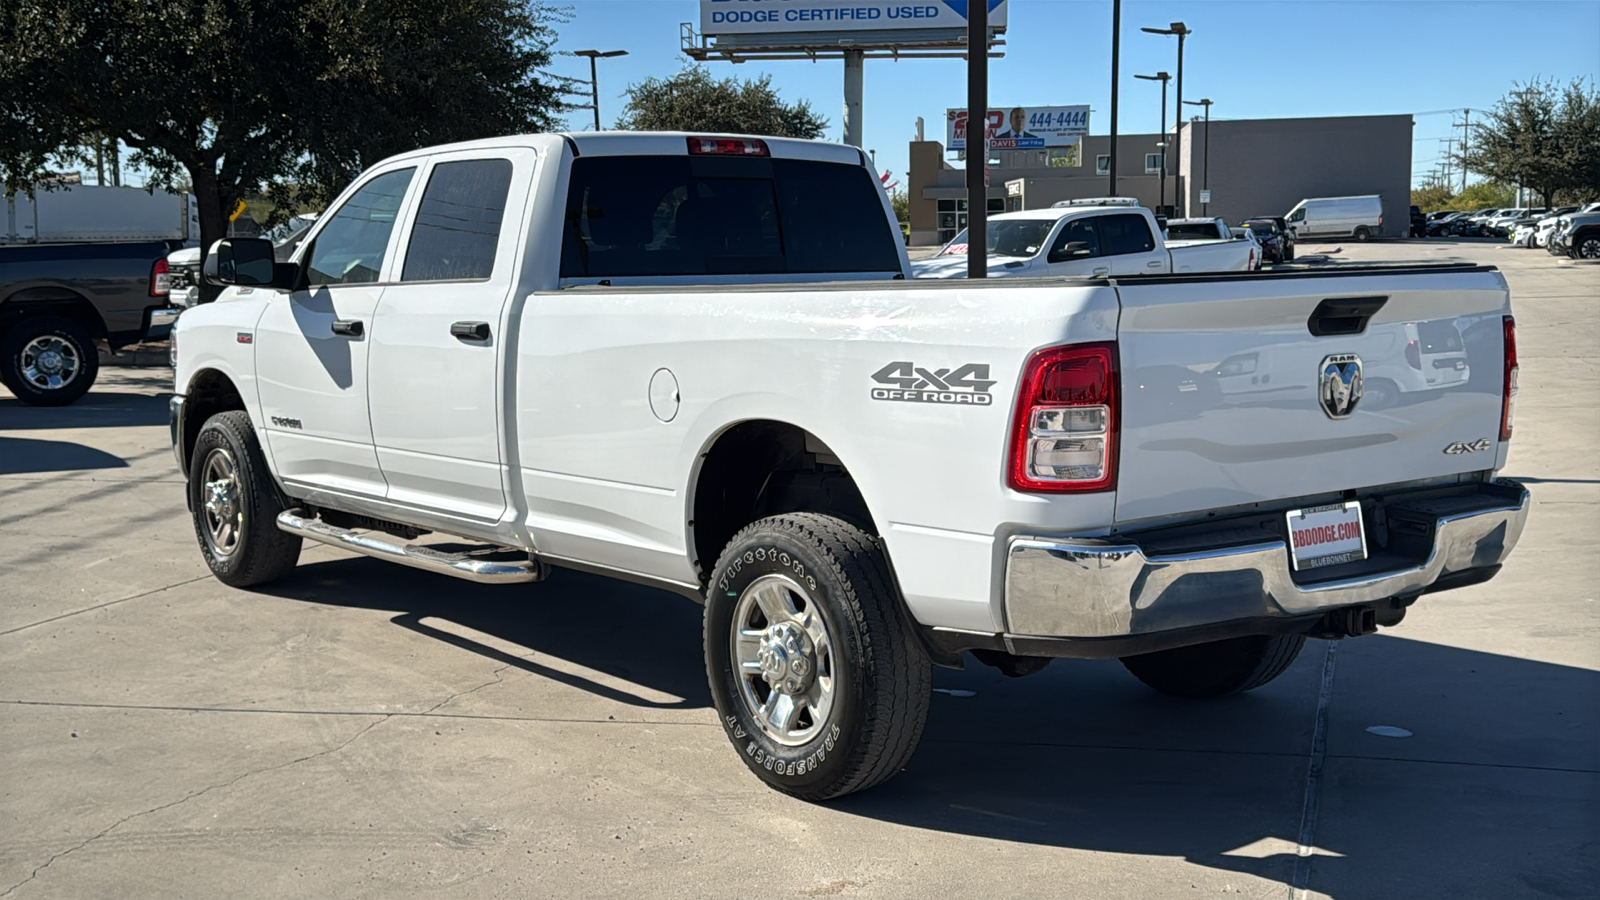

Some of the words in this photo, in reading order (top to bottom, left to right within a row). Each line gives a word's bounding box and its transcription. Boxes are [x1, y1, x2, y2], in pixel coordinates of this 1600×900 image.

[712, 10, 779, 23] DODGE
[784, 7, 881, 21] CERTIFIED
[887, 6, 939, 19] USED
[1029, 111, 1087, 127] 444-4444
[990, 140, 1017, 148] DAVIS
[873, 389, 918, 400] OFF
[922, 391, 990, 404] ROAD
[1292, 521, 1361, 548] BBDODGE.COM
[1310, 553, 1351, 567] BLUEBONNET
[718, 548, 818, 592] Firestone
[726, 715, 748, 740] AT
[746, 722, 841, 776] TRANSFORCE
